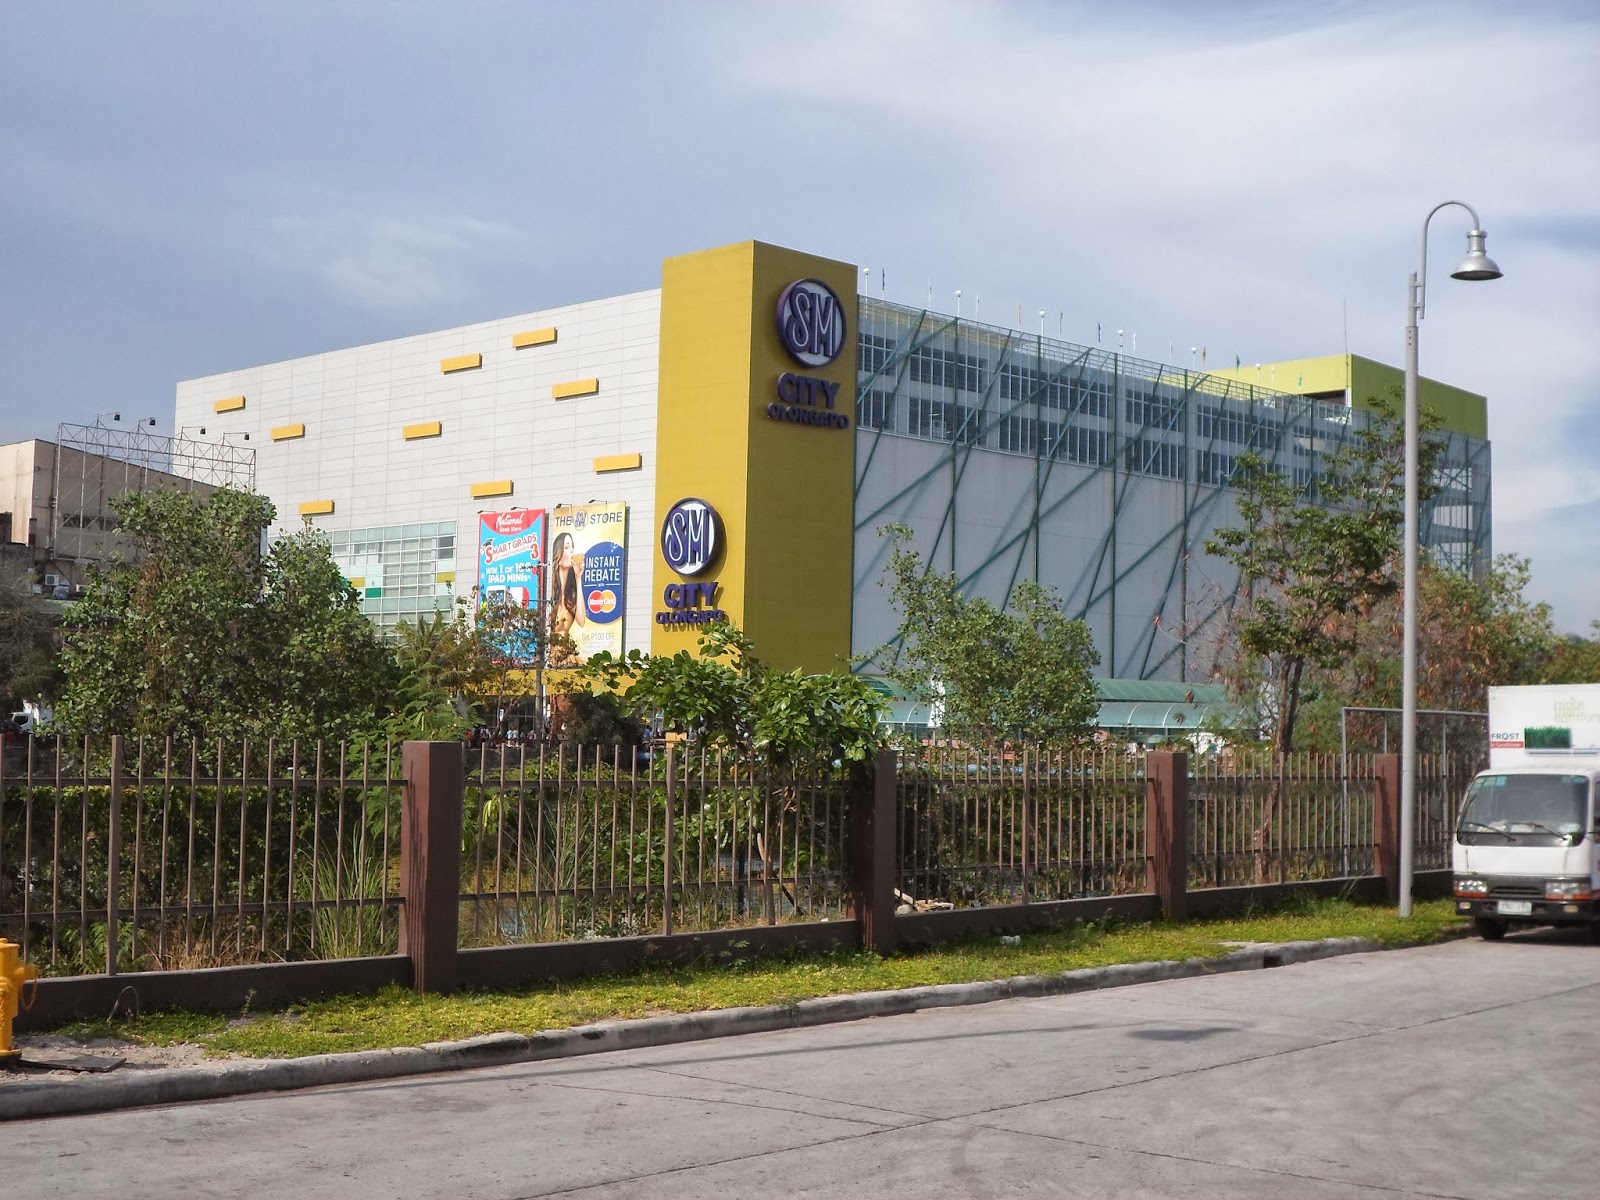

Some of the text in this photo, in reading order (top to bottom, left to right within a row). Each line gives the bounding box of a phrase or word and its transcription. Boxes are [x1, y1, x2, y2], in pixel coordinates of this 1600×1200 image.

[784, 285, 839, 358] SM
[777, 372, 841, 409] CITY
[767, 402, 850, 429] OLONGAPO
[496, 512, 525, 529] National
[555, 510, 622, 529] THE SM STORE
[665, 504, 712, 568] SM
[486, 541, 511, 564] SMART
[512, 533, 537, 549] GRADS
[531, 543, 539, 559] 3
[485, 567, 498, 575] WIN
[499, 563, 503, 573] 1
[585, 555, 620, 569] INSTANT
[584, 568, 620, 582] REBATE
[664, 582, 719, 608] CITY
[655, 609, 726, 625] OLONGAPO
[1491, 732, 1520, 740] FROST
